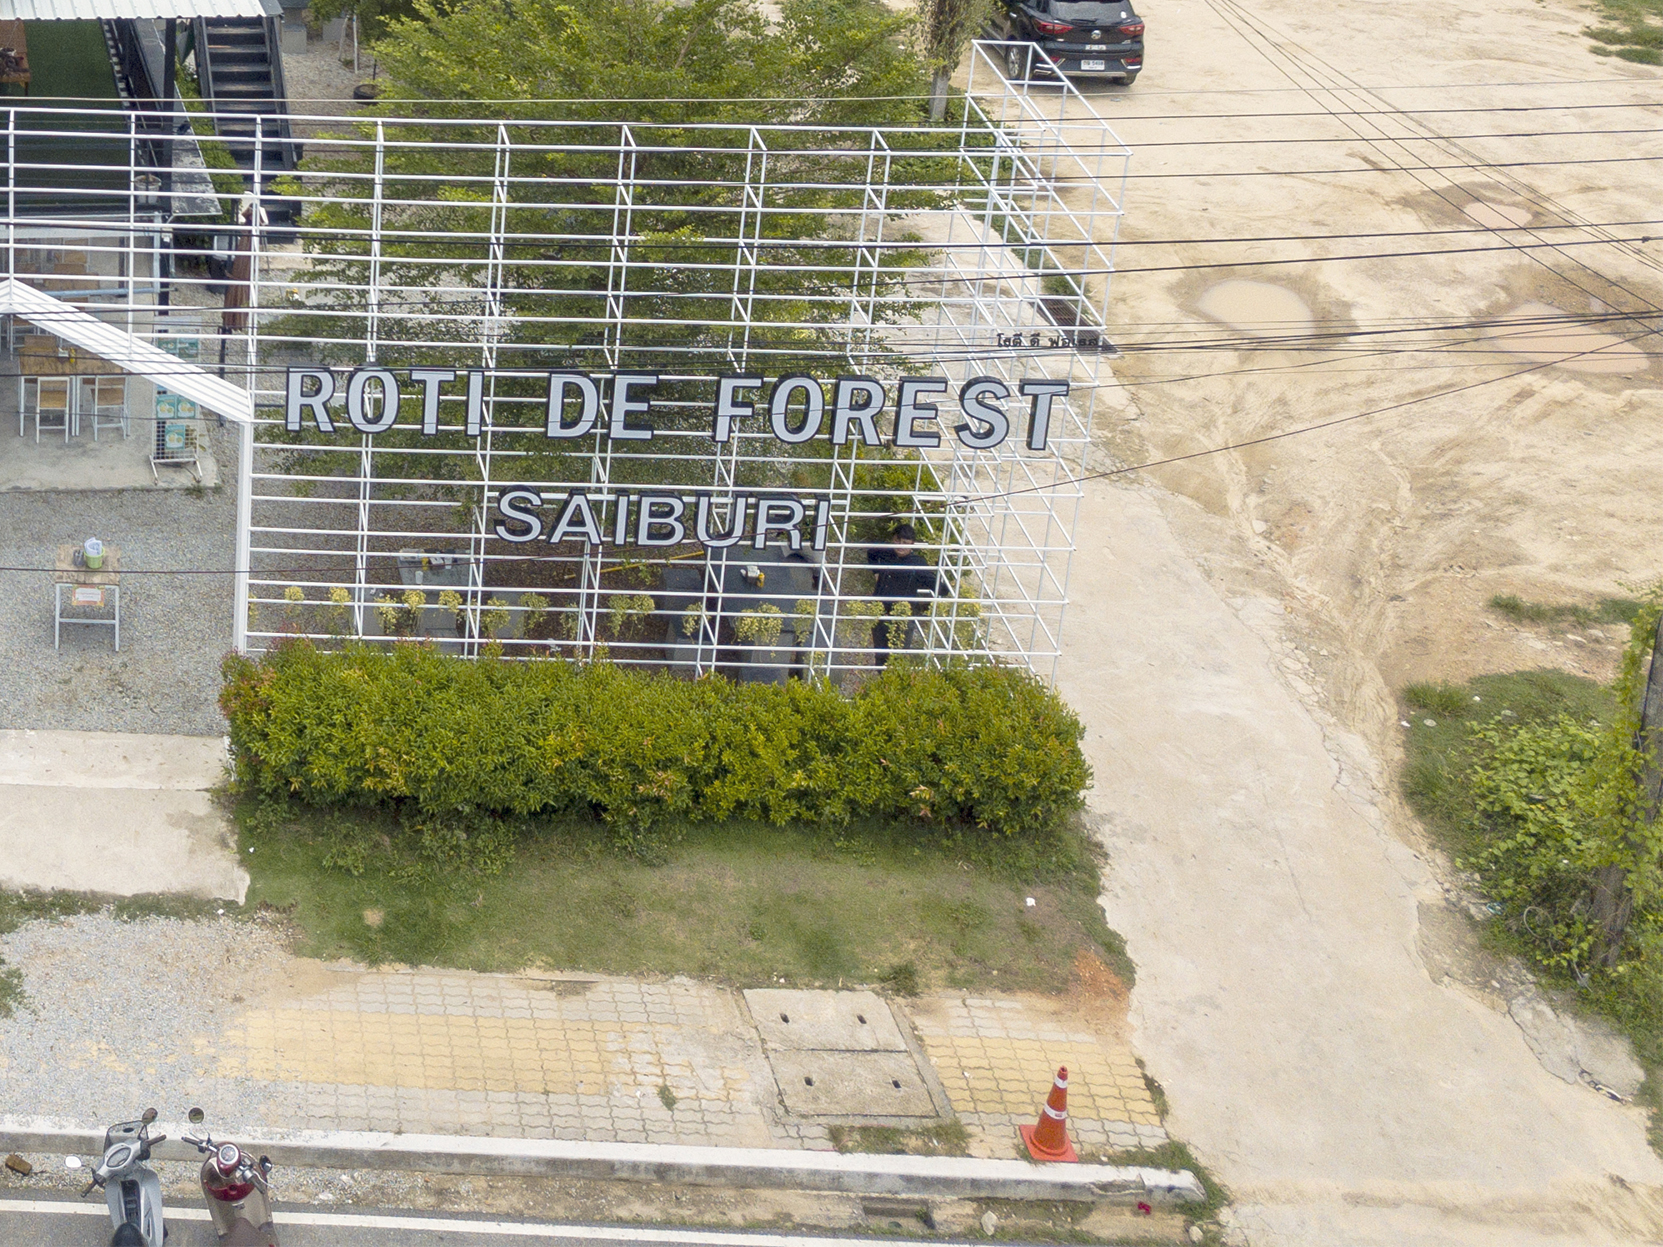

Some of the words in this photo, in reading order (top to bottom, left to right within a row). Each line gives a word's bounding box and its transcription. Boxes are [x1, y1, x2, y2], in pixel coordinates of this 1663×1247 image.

[285, 365, 485, 437] ROTI
[545, 370, 660, 441] DE
[711, 374, 1071, 451] FOREST
[493, 485, 832, 552] SAIBURI
